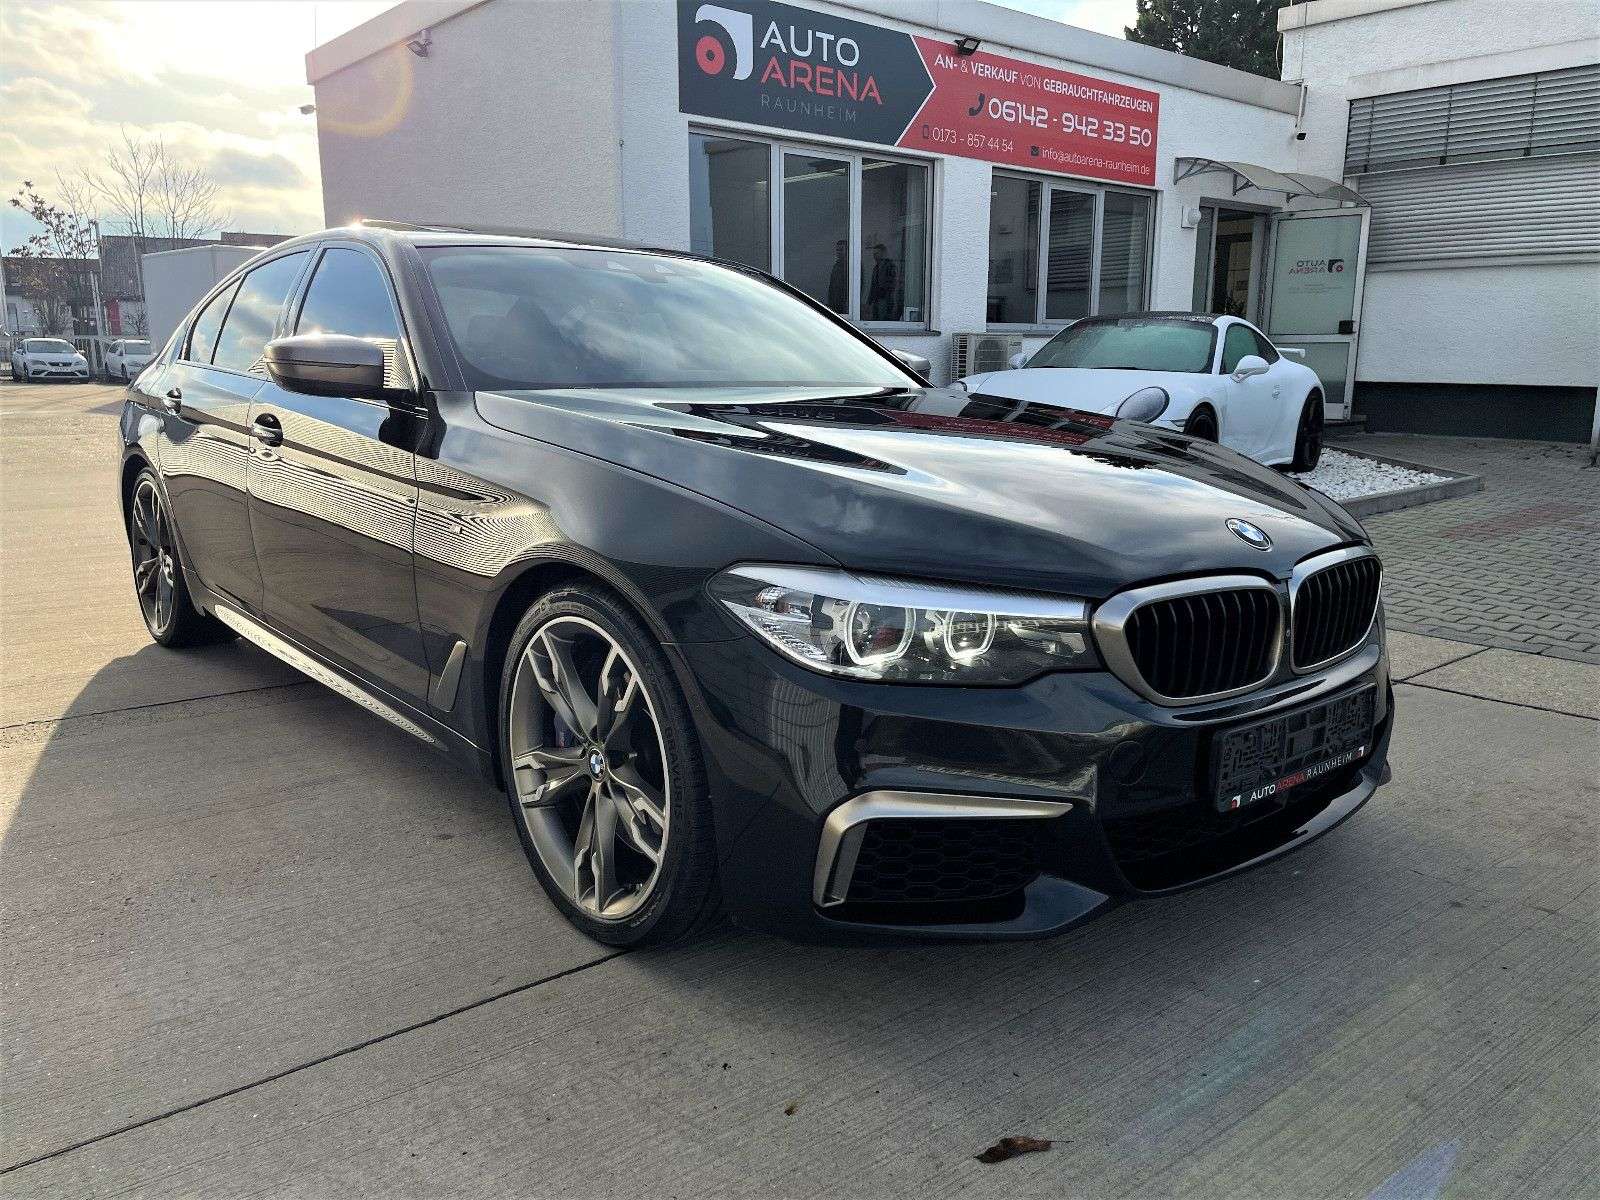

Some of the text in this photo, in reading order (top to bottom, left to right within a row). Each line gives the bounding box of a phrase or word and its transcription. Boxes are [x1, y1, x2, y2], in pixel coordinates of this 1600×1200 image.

[760, 21, 860, 67] AUTO
[760, 56, 883, 105] ARENA
[934, 54, 1153, 113] AN- & VERKAUF VON GEBRAUCHTFAHRZEUGEN
[761, 94, 857, 121] RAUNHEIM
[988, 97, 1048, 128] 06142
[1062, 112, 1098, 138] 942
[1102, 120, 1125, 143] 33
[1129, 126, 1152, 147] 50
[932, 127, 957, 144] 0173
[967, 133, 986, 148] 857
[987, 137, 999, 150] 44
[1001, 139, 1014, 152] 54
[1042, 146, 1150, 175] info@autoarena-raunheim.de
[1250, 784, 1276, 801] AUTO
[1306, 752, 1352, 780] RAUNHEIM
